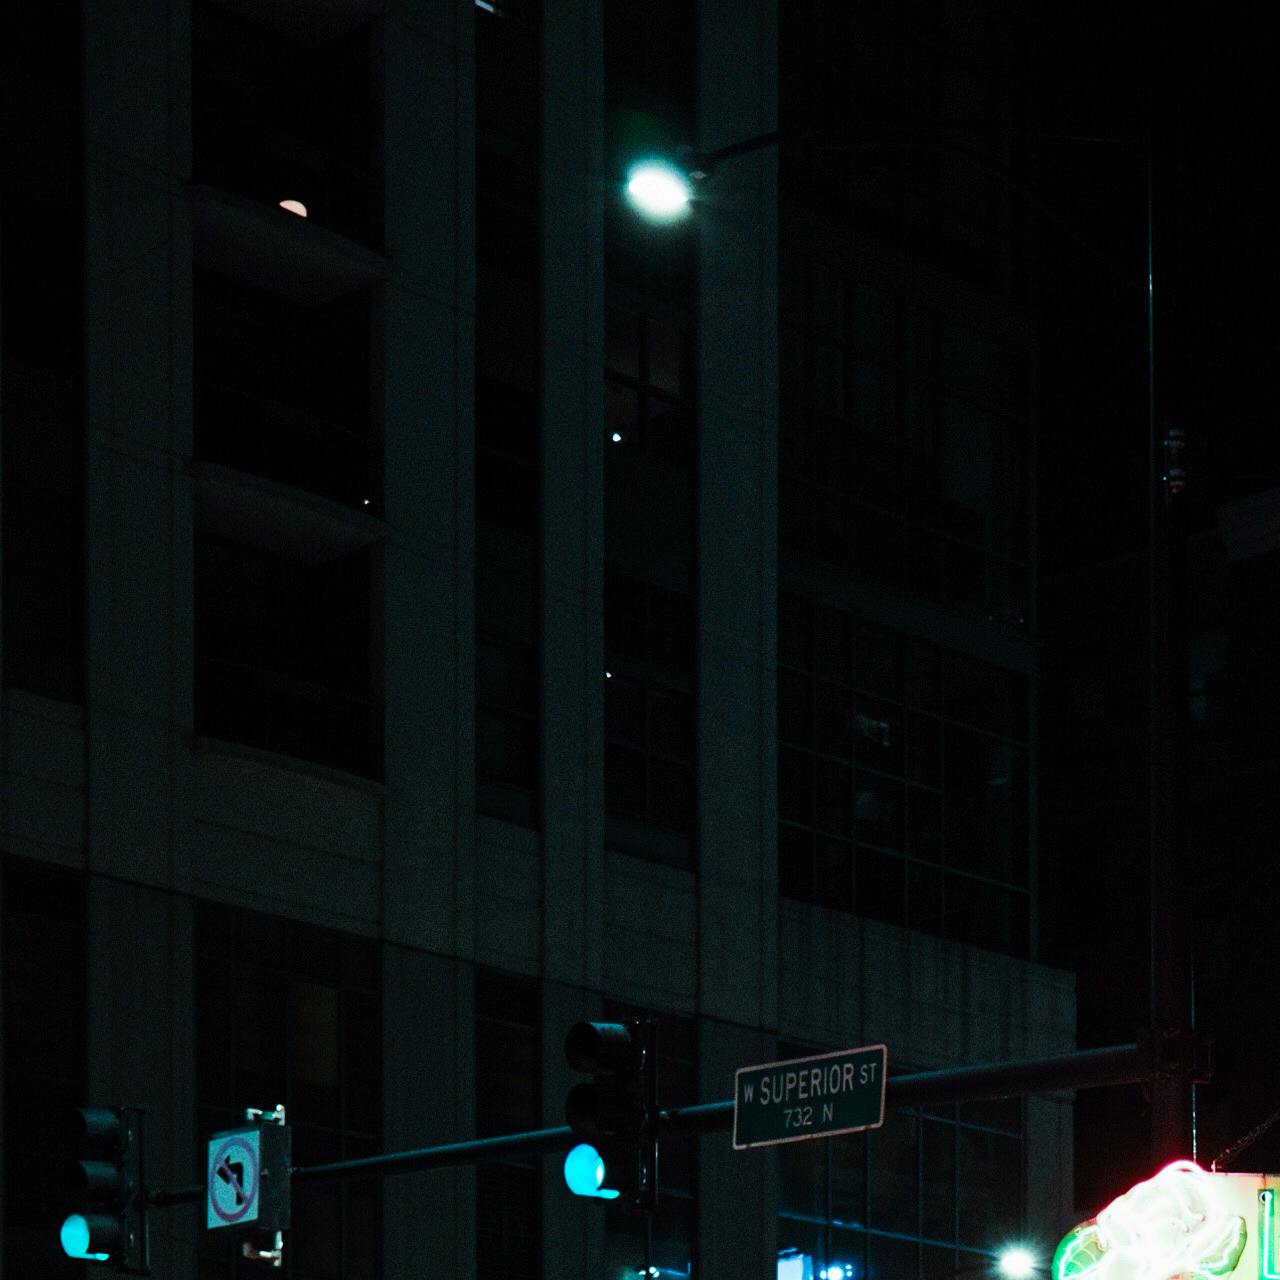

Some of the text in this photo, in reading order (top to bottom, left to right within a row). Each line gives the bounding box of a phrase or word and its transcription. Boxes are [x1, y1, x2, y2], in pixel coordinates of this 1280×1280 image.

[743, 1062, 878, 1106] W SUPERIOR ST
[783, 1101, 834, 1129] 732 N
